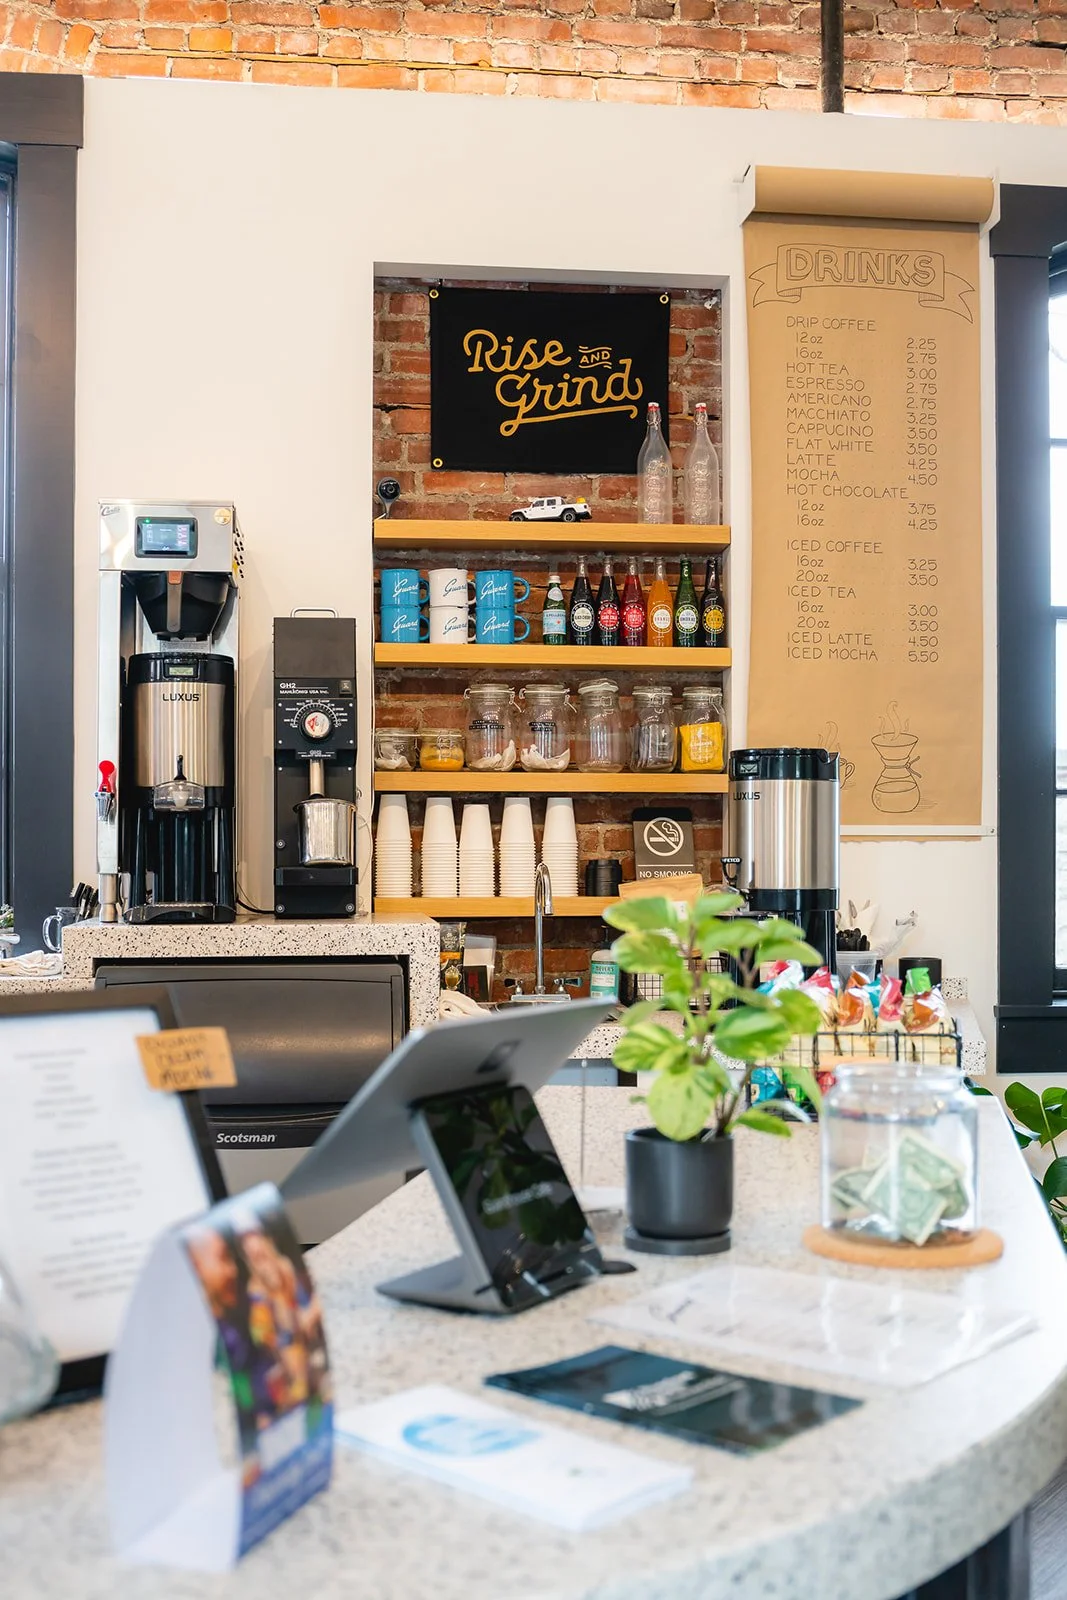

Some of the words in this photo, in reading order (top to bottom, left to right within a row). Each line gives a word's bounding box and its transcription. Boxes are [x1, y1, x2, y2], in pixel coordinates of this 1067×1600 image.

[785, 248, 936, 287] DRINKS
[786, 316, 819, 329] DRIP
[822, 317, 877, 332] COFFEE
[463, 329, 572, 372] Rise
[580, 350, 611, 365] AND
[906, 337, 937, 350] 2.25
[795, 347, 823, 359] 16oz
[906, 352, 937, 365] 2.75
[786, 362, 815, 374] HOT
[819, 363, 850, 376] TEA
[906, 367, 937, 380] 3.00
[786, 377, 865, 392] ESPRESSO
[906, 382, 938, 395] 2.75
[495, 358, 643, 436] Grind
[787, 392, 872, 407] AMERICANO
[906, 397, 937, 410] 2.75
[786, 407, 871, 422] MACCHIATO
[906, 412, 937, 426] 3.25
[786, 422, 874, 437] CAPPUCINO
[906, 427, 938, 440] 3.50
[786, 438, 823, 450] FLAT
[828, 440, 874, 452] WHITE
[906, 443, 938, 456] 3.50
[786, 454, 837, 466] LATTE
[907, 458, 938, 471] 4.25
[786, 468, 840, 481] MOCHA
[907, 473, 938, 486] 4.50
[786, 483, 817, 495] HOT
[822, 484, 909, 499] CHOCOLATE
[907, 502, 937, 516] 3.75
[796, 514, 825, 526] 16oz
[907, 518, 938, 531] 4.25
[786, 539, 821, 551] ICED
[825, 540, 883, 554] COFFEE
[796, 555, 824, 567] 16oz
[907, 558, 938, 571] 3.25
[796, 569, 829, 582] 20oz
[907, 573, 939, 587] 3.50
[392, 578, 419, 598] Guard
[787, 585, 821, 597] ICED
[827, 586, 857, 598] TEA
[797, 600, 825, 613] 16oz
[907, 604, 938, 617] 3.00
[391, 614, 419, 634] Guard
[797, 616, 830, 629] 20oz
[908, 619, 939, 632] 3.50
[787, 632, 823, 644] ICED
[828, 633, 873, 646] LATTE
[908, 635, 939, 648] 4.50
[787, 647, 822, 659] ICED
[828, 648, 878, 661] MOCHA
[908, 650, 939, 663] 5.50
[162, 693, 200, 702] LUXUS
[733, 791, 761, 801] LUXUS
[639, 870, 652, 878] NO
[216, 1132, 275, 1143] Scotsman
